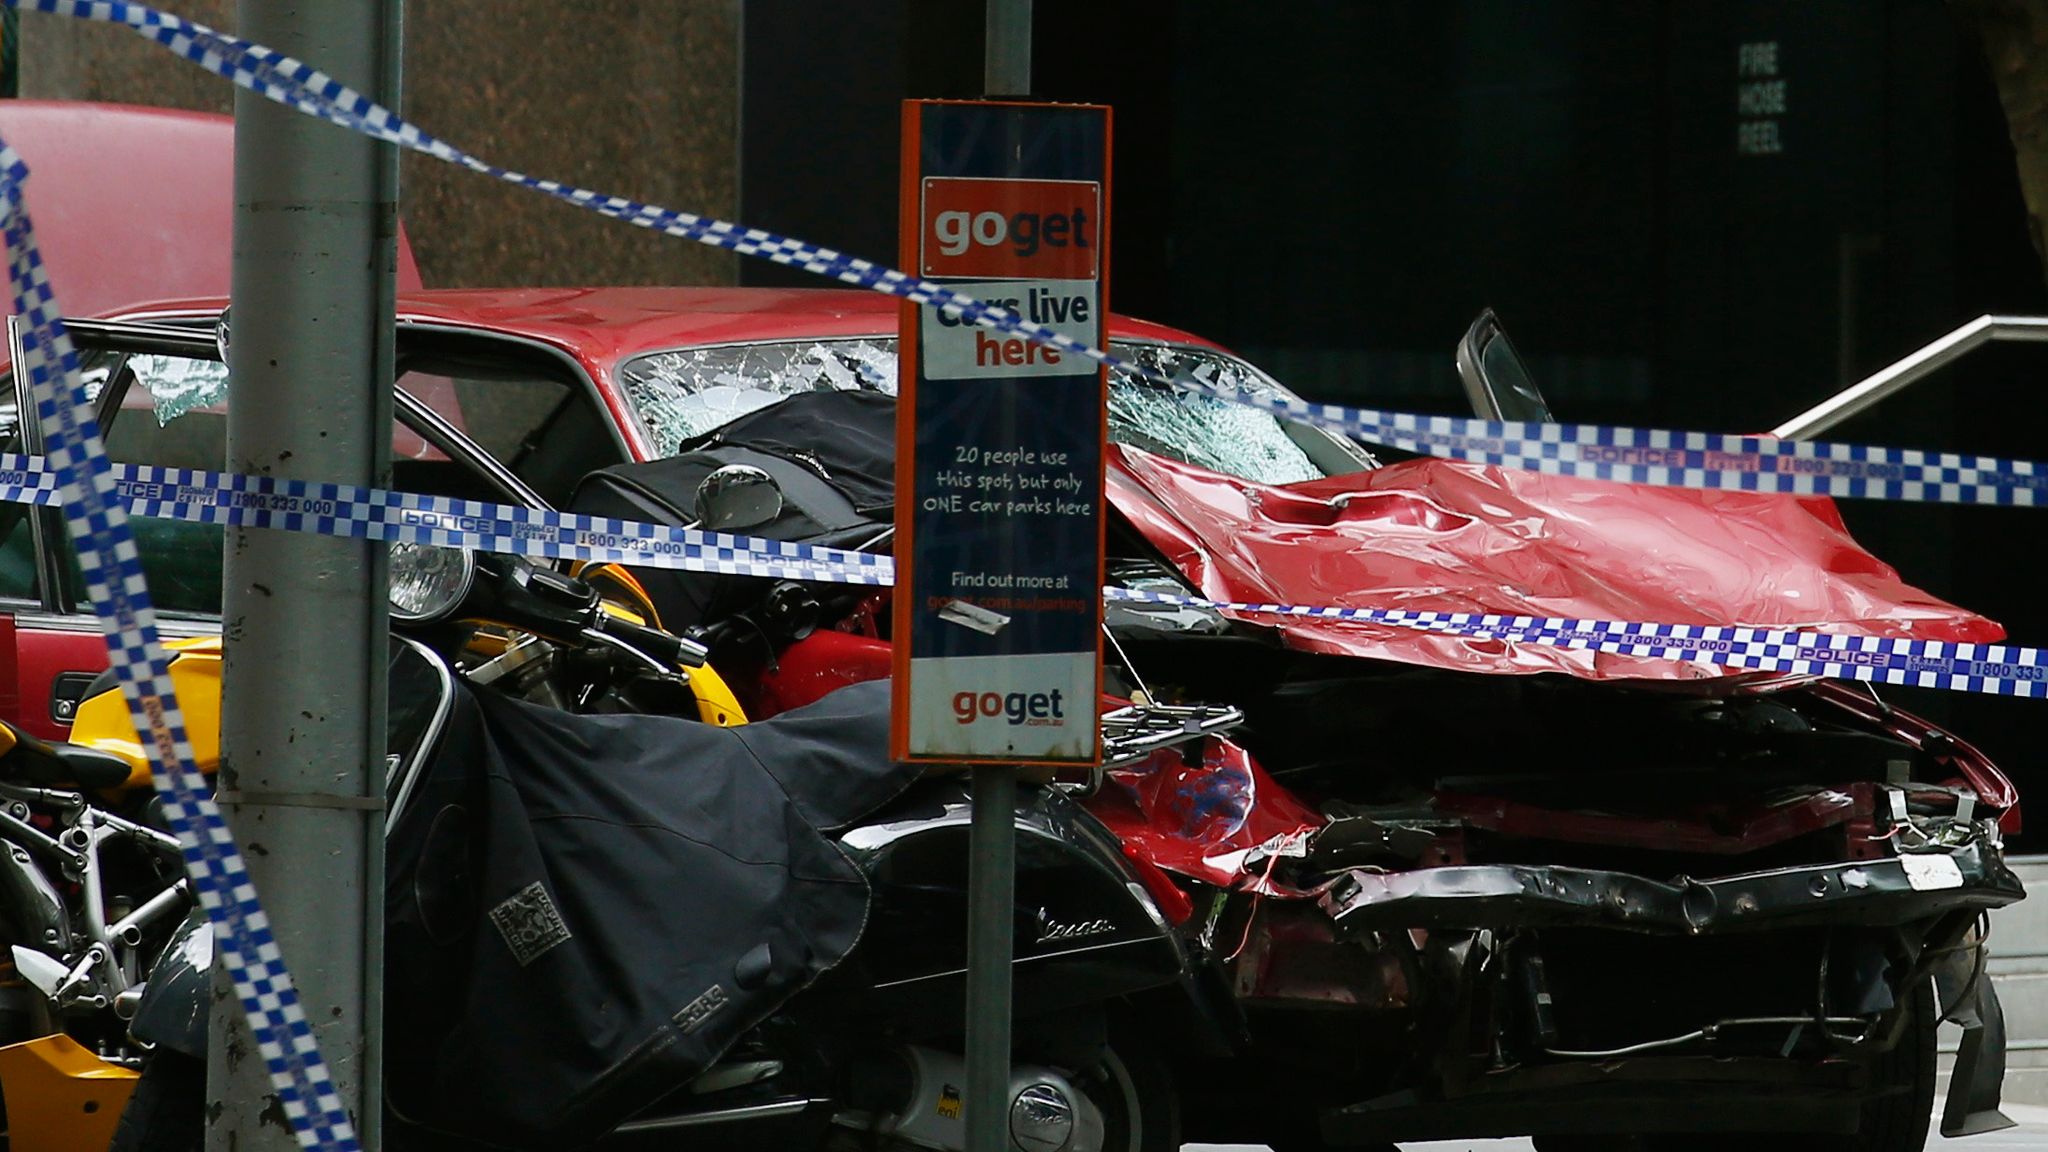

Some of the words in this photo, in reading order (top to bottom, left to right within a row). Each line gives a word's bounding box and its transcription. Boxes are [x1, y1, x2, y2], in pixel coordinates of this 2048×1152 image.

[1739, 42, 1778, 75] FIRE
[1739, 81, 1786, 114] HOSE
[1739, 121, 1781, 153] REEL
[934, 207, 1089, 257] goget
[1029, 288, 1089, 325] live
[976, 331, 1061, 367] here
[955, 446, 979, 464] 20
[983, 447, 1036, 467] people
[1040, 452, 1068, 466] use
[936, 470, 973, 489] this
[977, 472, 1015, 492] spot,
[1018, 473, 1049, 489] but
[1053, 471, 1083, 495] only
[923, 495, 963, 513] ONE
[968, 500, 1002, 513] car
[1006, 496, 1051, 517] parks
[1056, 498, 1091, 516] here
[952, 572, 985, 588] Find
[987, 574, 1014, 588] out
[1016, 576, 1054, 589] more
[1055, 575, 1069, 589] at
[1626, 634, 1662, 646] 1800
[1666, 638, 1695, 649] 333
[1699, 641, 1727, 651] 000
[1800, 647, 1885, 666] POLICE
[1975, 662, 2011, 677] 1800
[2015, 665, 2044, 680] 333
[952, 688, 1064, 726] goget
[1036, 906, 1117, 943] Vespa
[938, 1105, 959, 1120] eni
